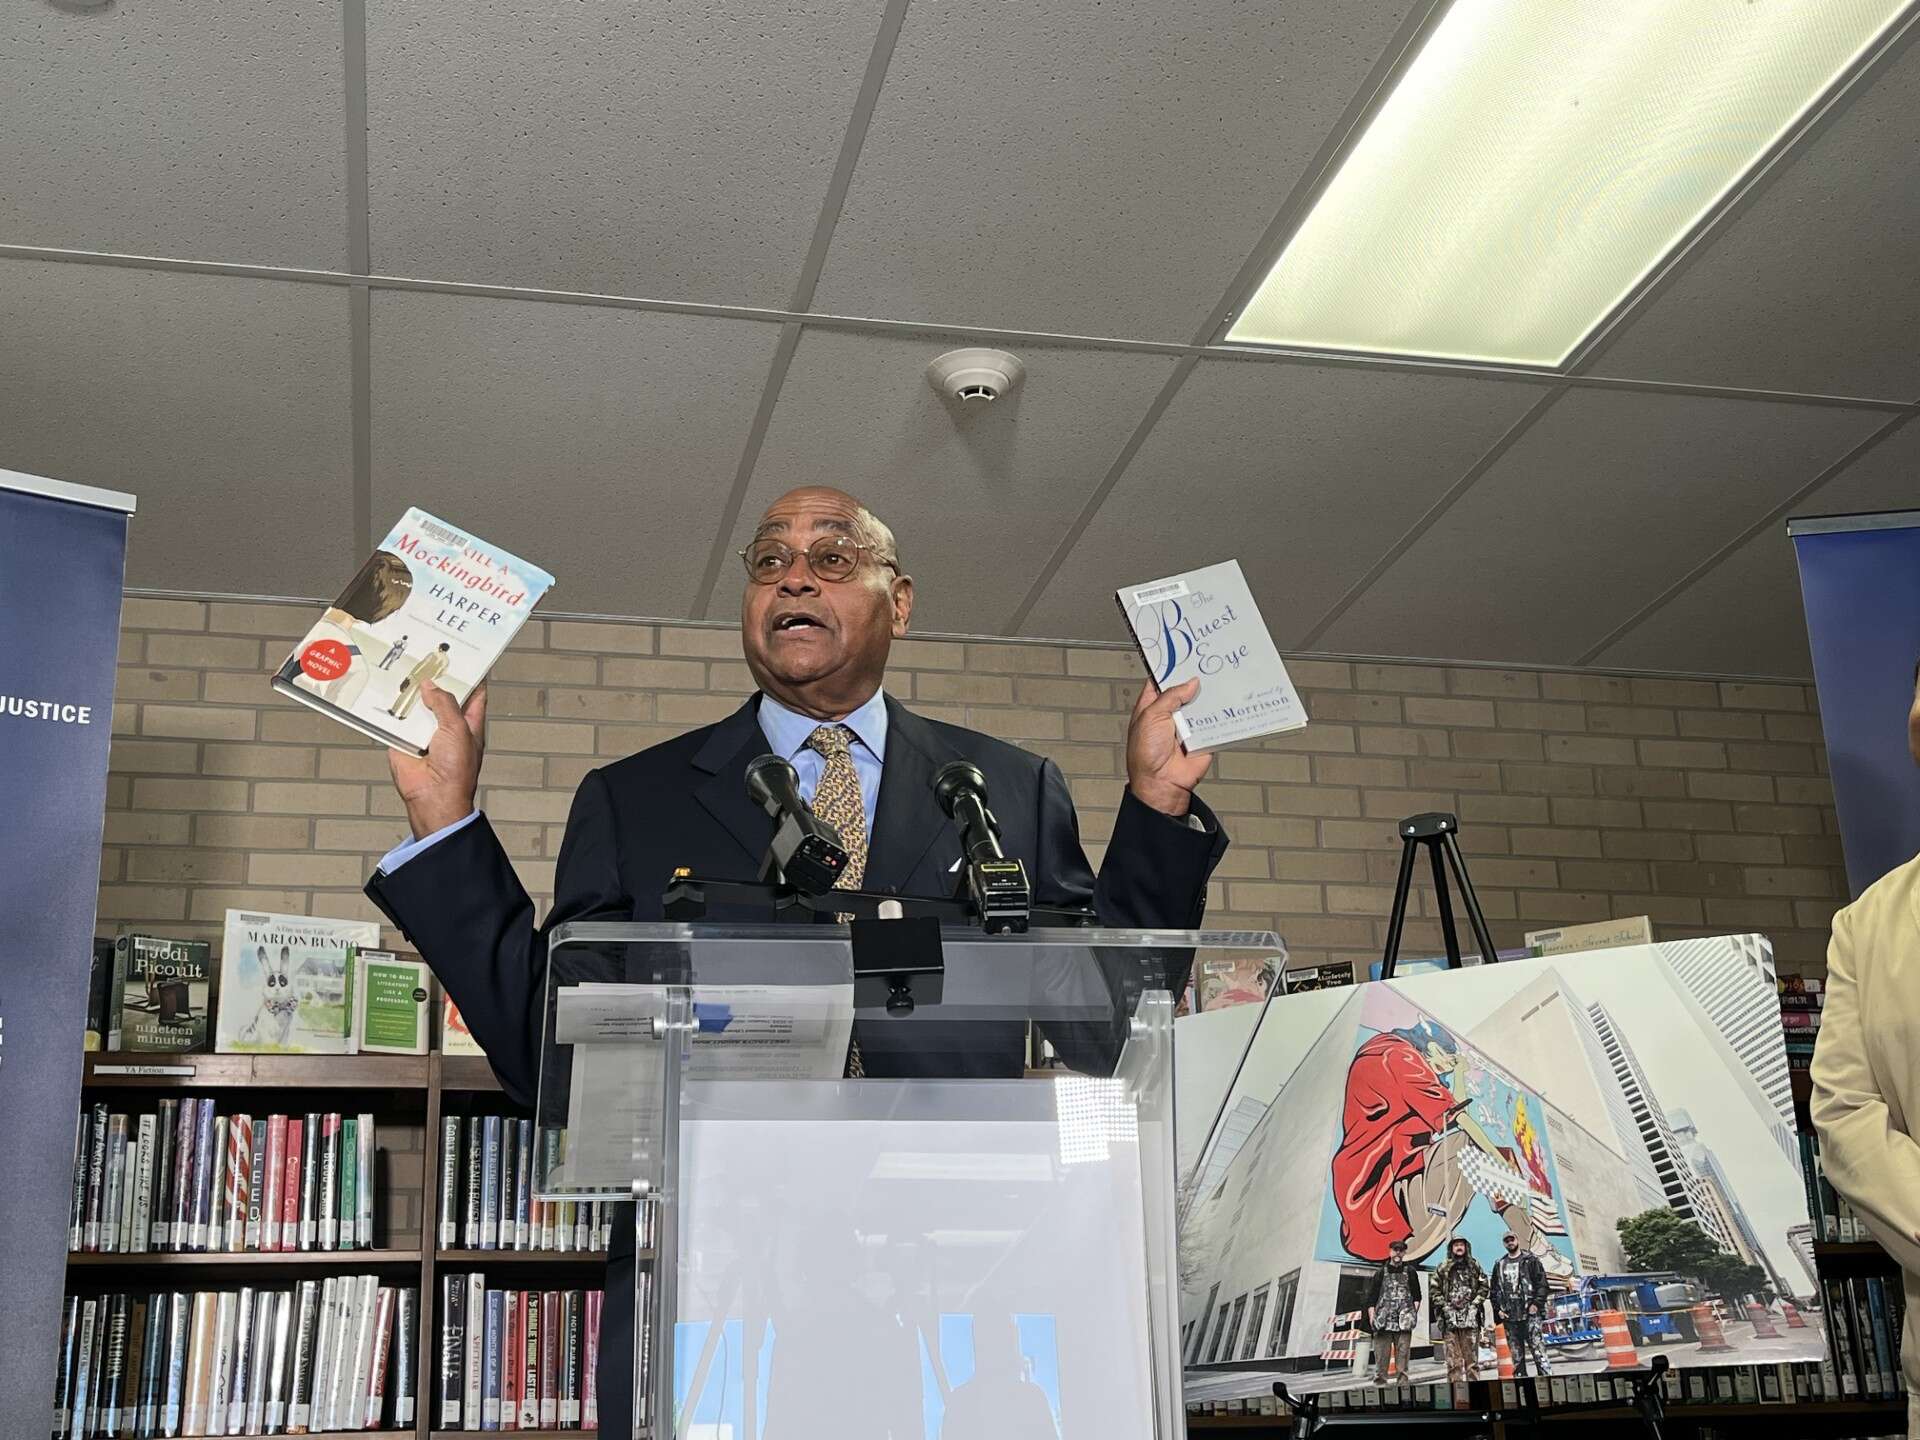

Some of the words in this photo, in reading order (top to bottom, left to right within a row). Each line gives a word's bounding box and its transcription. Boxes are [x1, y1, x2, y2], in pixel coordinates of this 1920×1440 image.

[394, 533, 525, 606] Mockingbird
[500, 565, 509, 575] A
[428, 583, 503, 627] HARPER
[1190, 591, 1215, 608] The
[436, 609, 469, 632] LEE
[1140, 598, 1239, 684] Bluest
[306, 659, 331, 676] NOVEL
[309, 649, 343, 669] GRAPHIC
[1196, 643, 1250, 676] Eye
[0, 695, 91, 724] JUSTICE
[1185, 714, 1219, 729] Toni
[1222, 696, 1290, 720] Morrison
[248, 931, 307, 947] MARLON
[311, 936, 359, 949] BUNDO
[149, 946, 189, 962] Jodi
[135, 959, 203, 978] Picoult
[135, 1024, 194, 1035] nineteen
[137, 1035, 192, 1046] minutes
[138, 1066, 165, 1074] Fiction
[143, 1120, 152, 1128] IT
[140, 1133, 150, 1164] LOOKS
[446, 1124, 457, 1152] GODLY
[138, 1167, 149, 1191] LIKE
[470, 1147, 481, 1190] SEVENTH
[488, 1153, 497, 1185] TRUTHS
[250, 1153, 263, 1222] FEED
[137, 1196, 148, 1208] US
[527, 1308, 538, 1338] CHARLIE
[570, 1334, 577, 1344] SO
[441, 1324, 464, 1379] FINALE
[471, 1335, 480, 1390] SPECTACULAR
[490, 1358, 497, 1367] OF
[527, 1339, 537, 1366] THORNE
[527, 1369, 536, 1387] LAST
